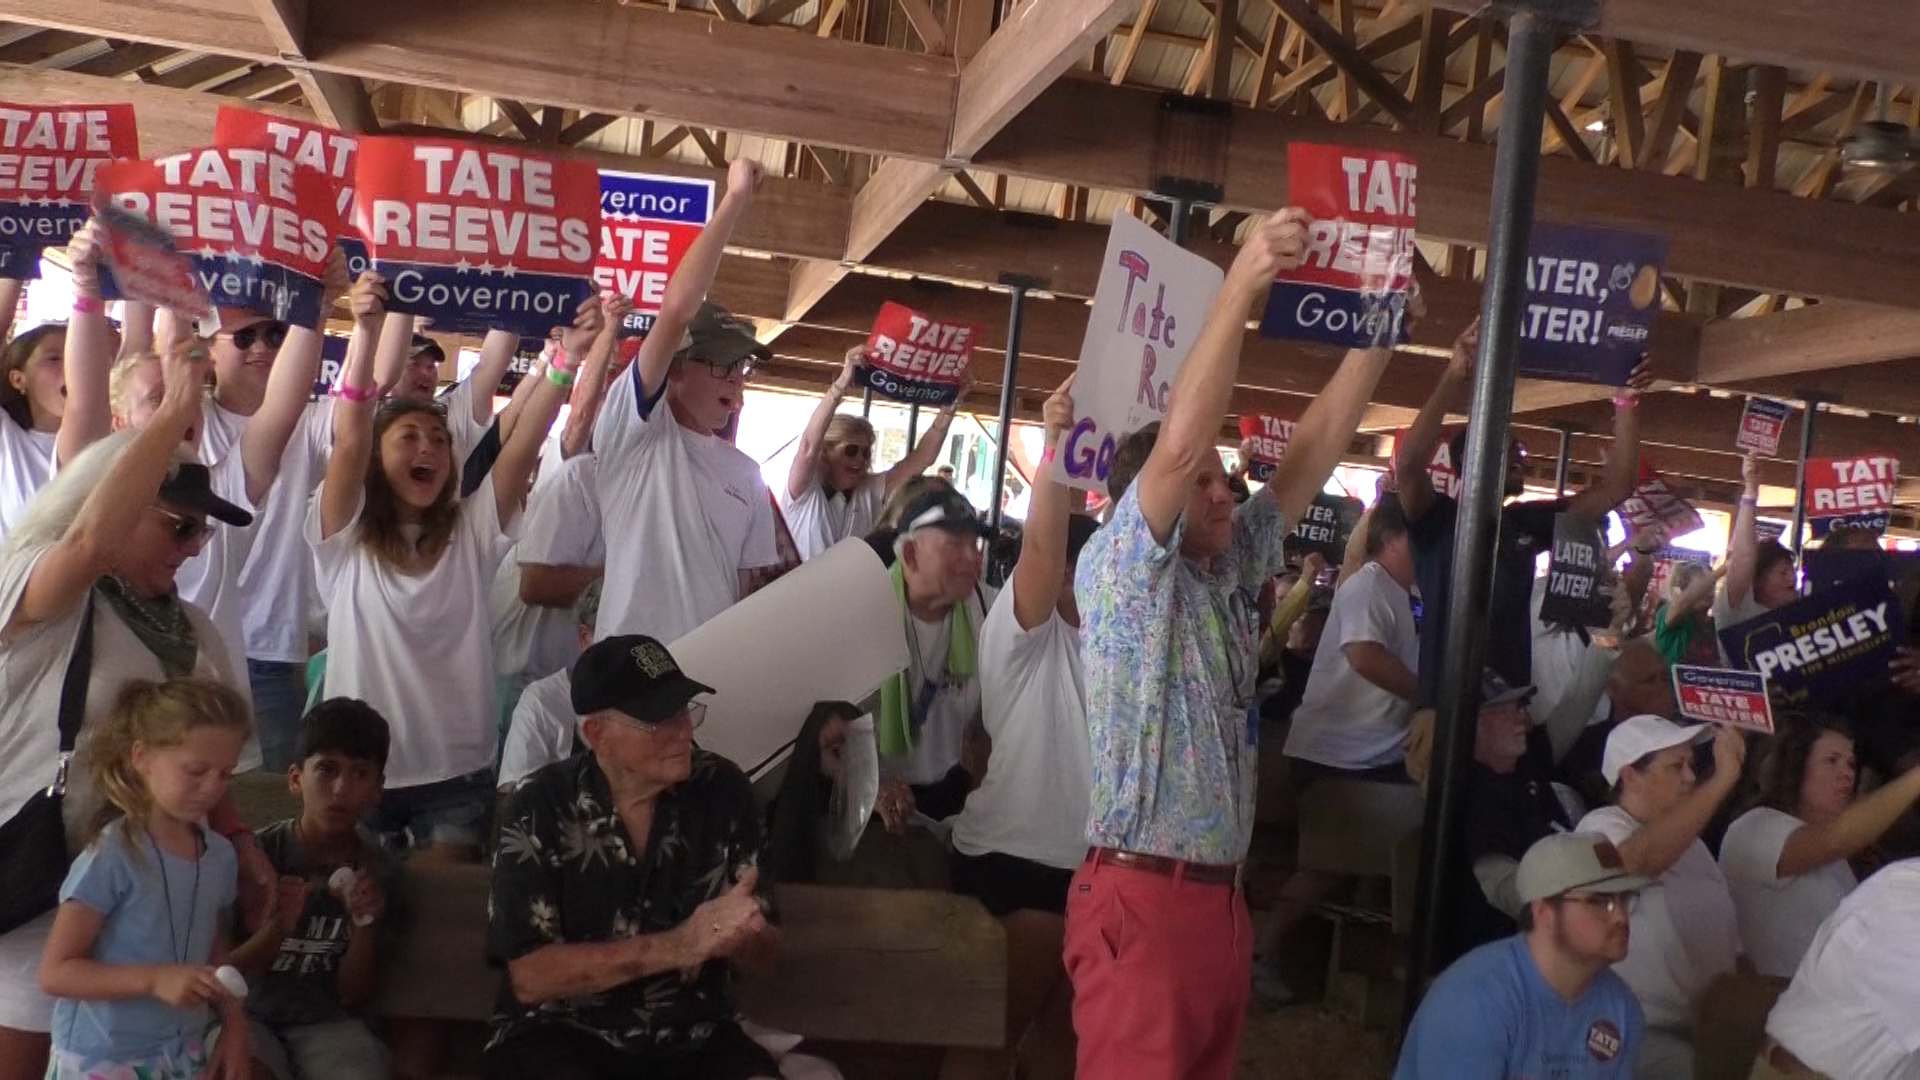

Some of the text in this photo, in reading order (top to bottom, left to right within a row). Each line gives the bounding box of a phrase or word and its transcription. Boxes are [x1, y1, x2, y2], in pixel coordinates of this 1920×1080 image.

[0, 109, 111, 151] TATE
[267, 122, 358, 178] TAT
[154, 148, 297, 205] TATE
[414, 145, 556, 209] TATE
[373, 199, 591, 263] REEVES
[393, 270, 570, 314] Governor
[1117, 250, 1176, 349] Tate
[907, 316, 970, 350] TATE
[1520, 304, 1604, 345] TER!
[871, 334, 968, 377] REEVES
[870, 370, 946, 399] Governor
[1261, 416, 1298, 440] TAT
[1554, 540, 1597, 573] LATER,
[1550, 571, 1595, 599] TATER!
[1755, 602, 1888, 681] PRESLEY
[1696, 690, 1750, 709] TATE
